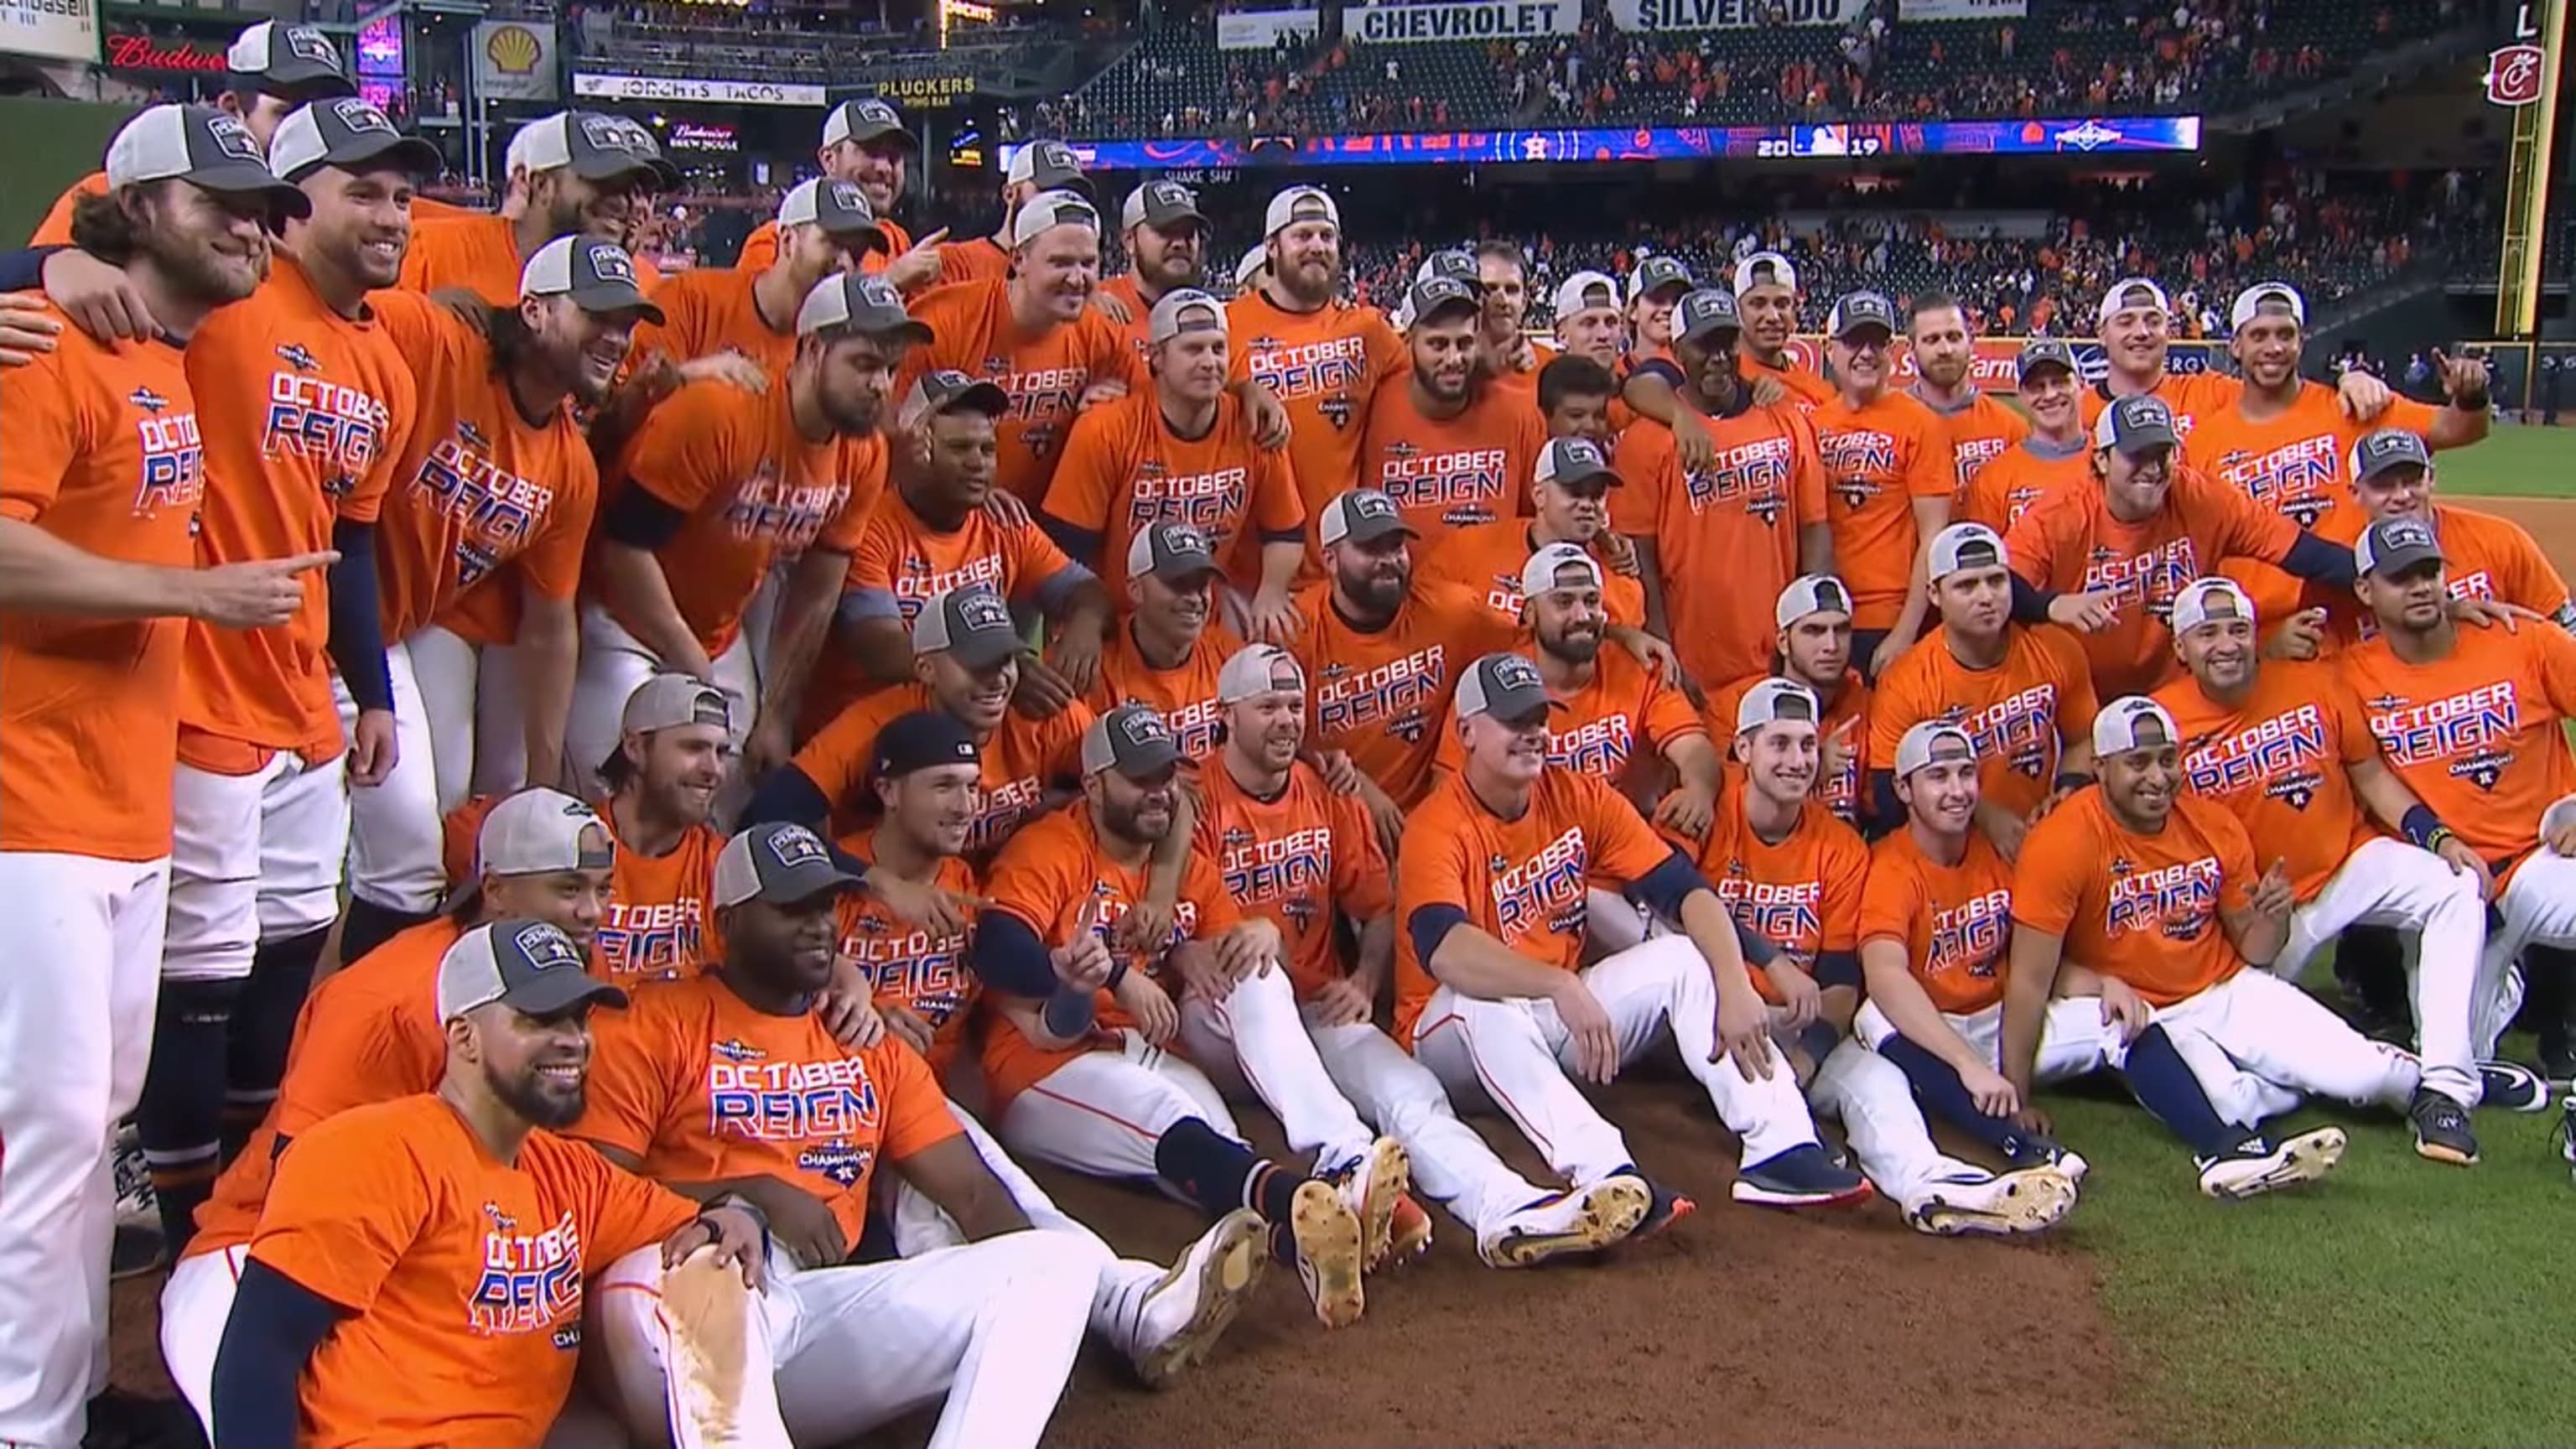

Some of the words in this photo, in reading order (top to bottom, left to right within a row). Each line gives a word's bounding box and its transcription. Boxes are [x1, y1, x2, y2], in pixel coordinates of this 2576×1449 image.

[1364, 3, 1559, 39] CHEVROLET
[2516, 4, 2537, 36] L
[107, 34, 226, 70] Budwe
[725, 85, 784, 101] TACOS
[879, 77, 975, 96] PLUCKERS
[1758, 140, 1789, 156] 20
[1851, 139, 1880, 155] 19
[1249, 336, 1363, 374] OCTOBER
[2167, 356, 2210, 373] ERGY
[1254, 356, 1368, 402] REIGN
[1004, 390, 1083, 421] EIGN
[139, 414, 200, 452] OCTO
[1714, 436, 1791, 471] TOBER
[1818, 430, 1893, 454] CTOBER
[432, 439, 554, 514] OCTOBER
[1383, 450, 1505, 480] OCTOBER
[1820, 449, 1893, 475] EIGN
[2220, 434, 2336, 480] OCTOBER
[2249, 453, 2340, 503] EIGN
[407, 455, 545, 549] REIGN
[1135, 467, 1247, 499] OCTOBER
[1382, 470, 1505, 509] REIGN
[1683, 459, 1791, 516] REIGN
[1128, 486, 1248, 531] REIGN
[2086, 538, 2192, 583] OCTOBER
[1317, 644, 1444, 703] OCTOBER
[1317, 659, 1446, 738] REIGN
[1961, 683, 2054, 735] CTOBER
[2371, 681, 2516, 735] OCTOBER
[1547, 713, 1628, 753] TOBER
[1972, 704, 2054, 761] EIGN
[2185, 703, 2319, 769] OCTOBER
[2375, 703, 2520, 767] REIGN
[2189, 727, 2325, 797] REIGN
[1223, 828, 1331, 870] OCTOBER
[1492, 826, 1584, 902] OCTOBER
[1221, 852, 1331, 904] REIGN
[1499, 852, 1589, 946] REIGN
[1719, 880, 1820, 905] OCTOBER
[2109, 855, 2220, 902] OCTOBER
[609, 896, 701, 930] TOBER
[1929, 889, 2011, 934] CTOBER
[2106, 877, 2221, 941] REIGN
[598, 925, 703, 974] EIGN
[711, 1056, 868, 1091] OCTOBER
[710, 1083, 879, 1141] REIGN
[485, 1209, 579, 1271] OCTOBE
[468, 1258, 581, 1336] REIG
